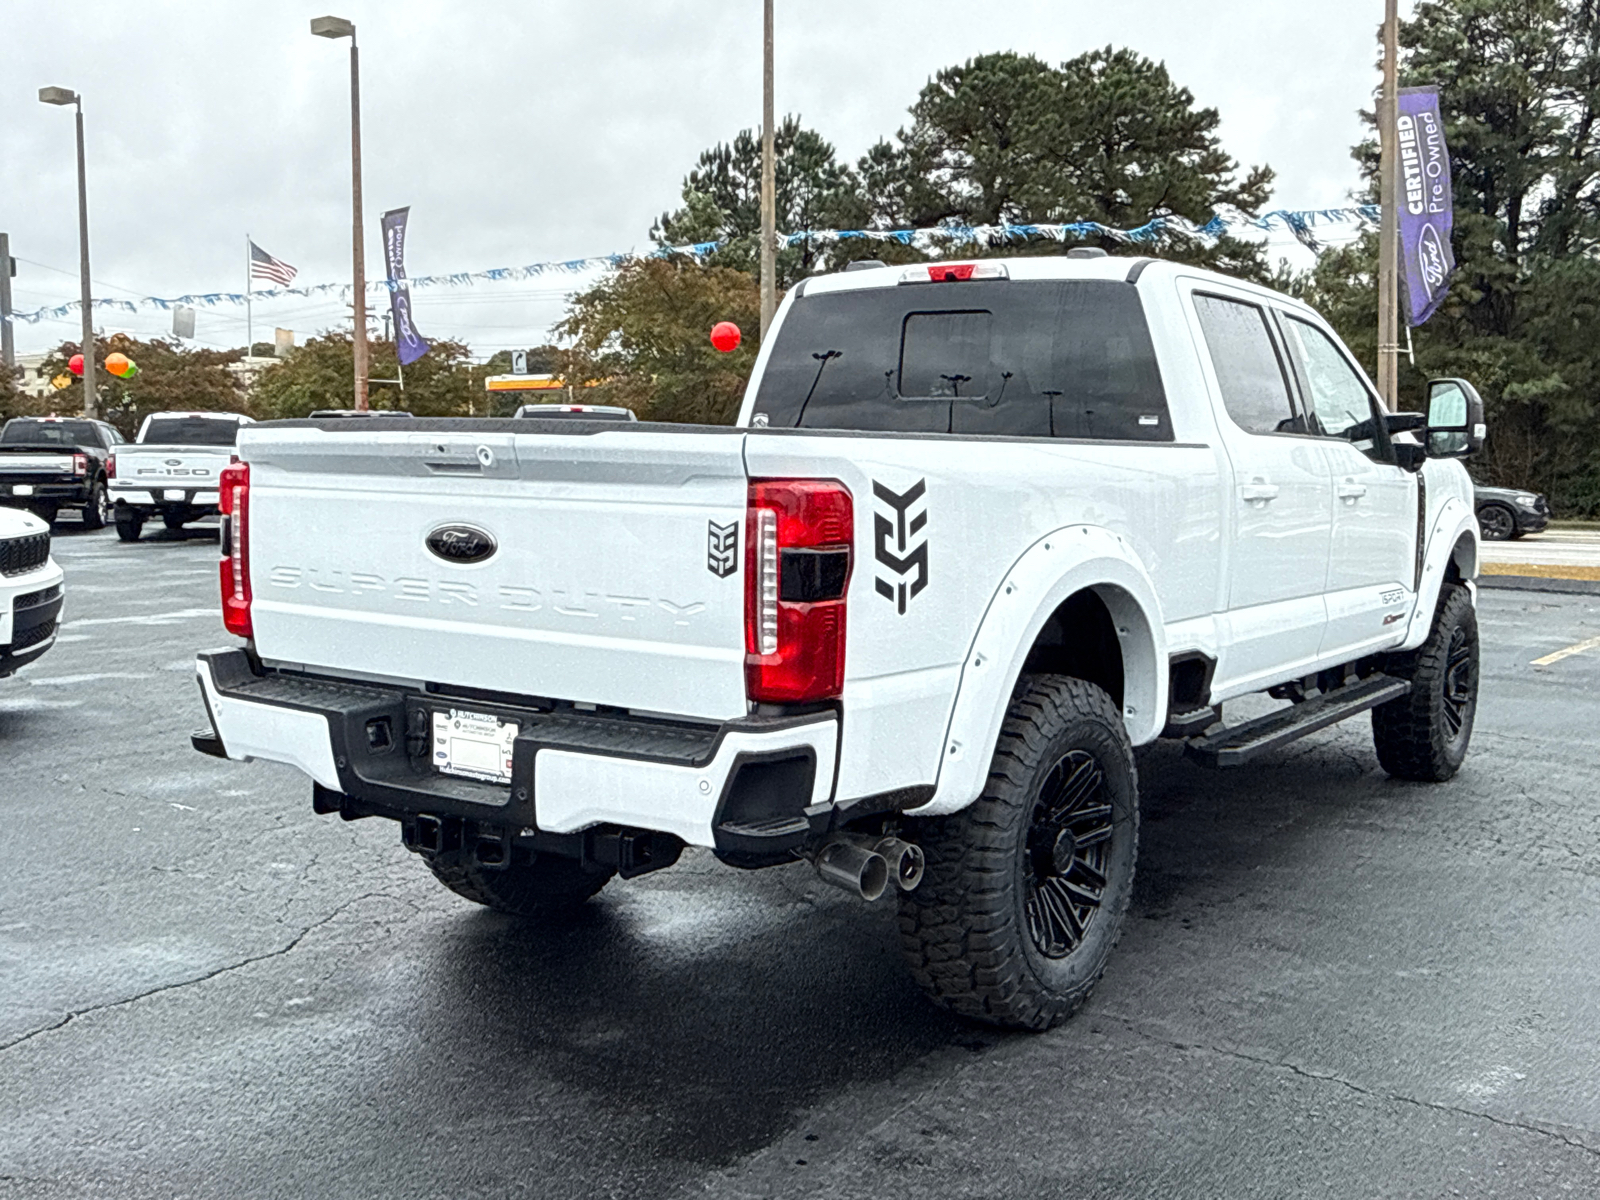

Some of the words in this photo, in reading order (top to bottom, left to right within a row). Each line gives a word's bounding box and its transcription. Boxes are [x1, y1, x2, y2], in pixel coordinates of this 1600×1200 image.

[1397, 115, 1424, 215] CERTIFIED
[1418, 112, 1444, 213] Pre-Owned
[1423, 241, 1443, 286] Ford
[442, 530, 479, 556] Ford
[270, 566, 478, 606] SUPER
[499, 586, 706, 626] DUTY
[457, 711, 497, 722] HUTCHINSON
